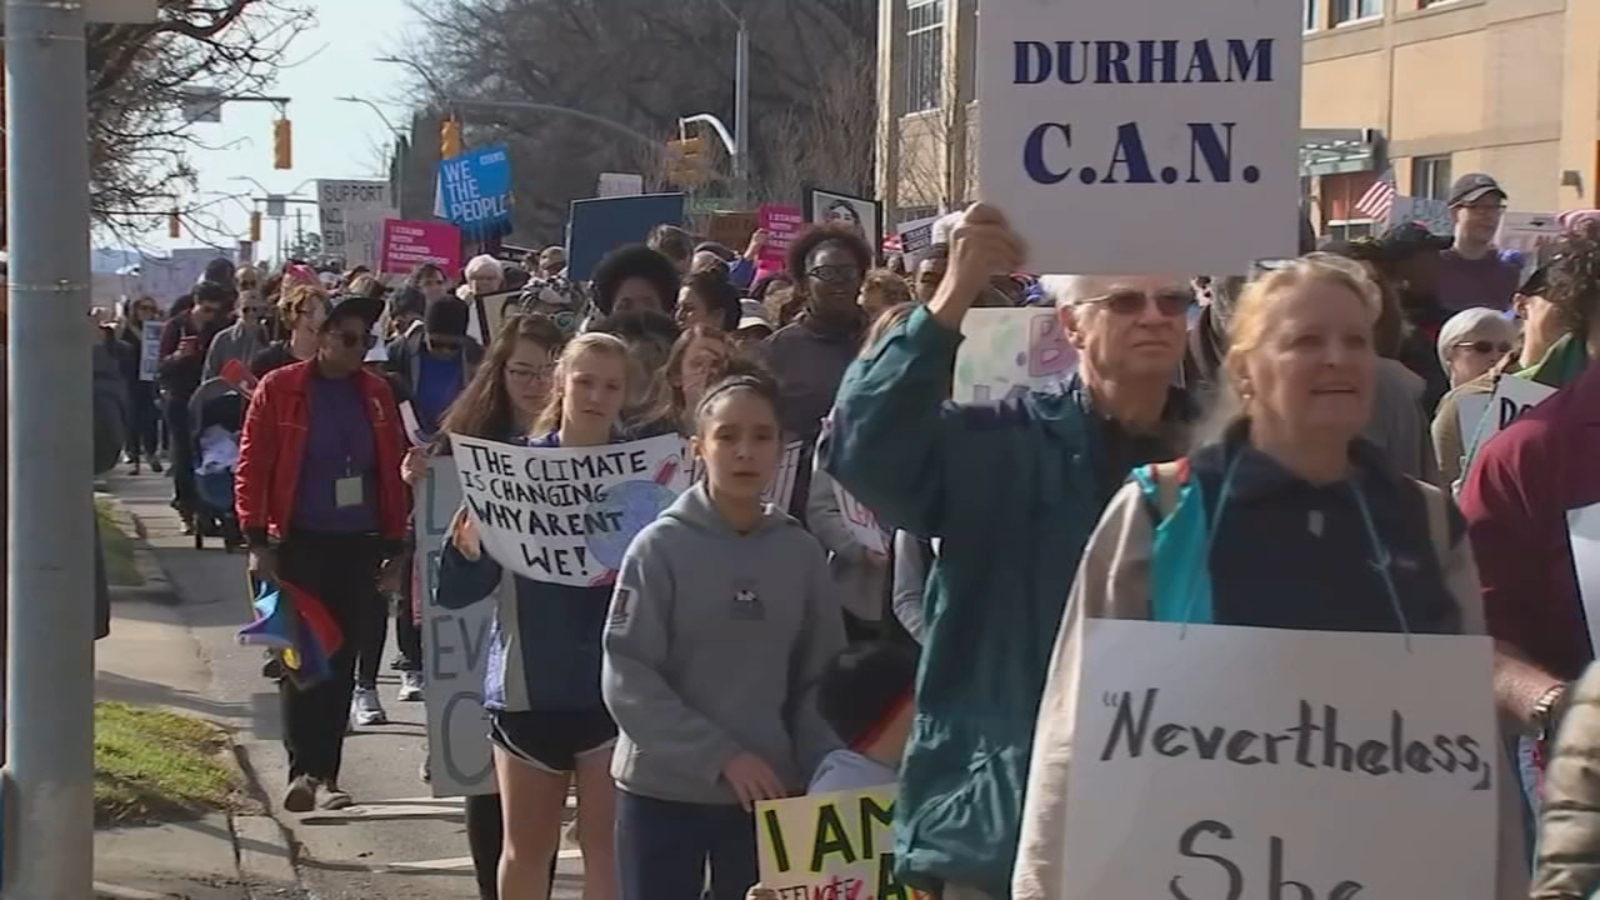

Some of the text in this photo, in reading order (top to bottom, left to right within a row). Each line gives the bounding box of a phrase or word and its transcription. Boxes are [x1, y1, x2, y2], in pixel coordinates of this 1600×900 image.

[1013, 38, 1276, 85] DURHAM
[443, 160, 471, 182] WE
[1023, 121, 1260, 185] C.A.N.
[324, 185, 384, 202] SUPPORT
[446, 178, 480, 203] THE
[460, 443, 516, 476] THE
[525, 450, 647, 481] CLIMATE
[461, 470, 609, 507] IS CHANGING
[467, 494, 624, 536] WHY ARENT
[520, 543, 588, 576] WE!
[764, 797, 897, 872] I AM
